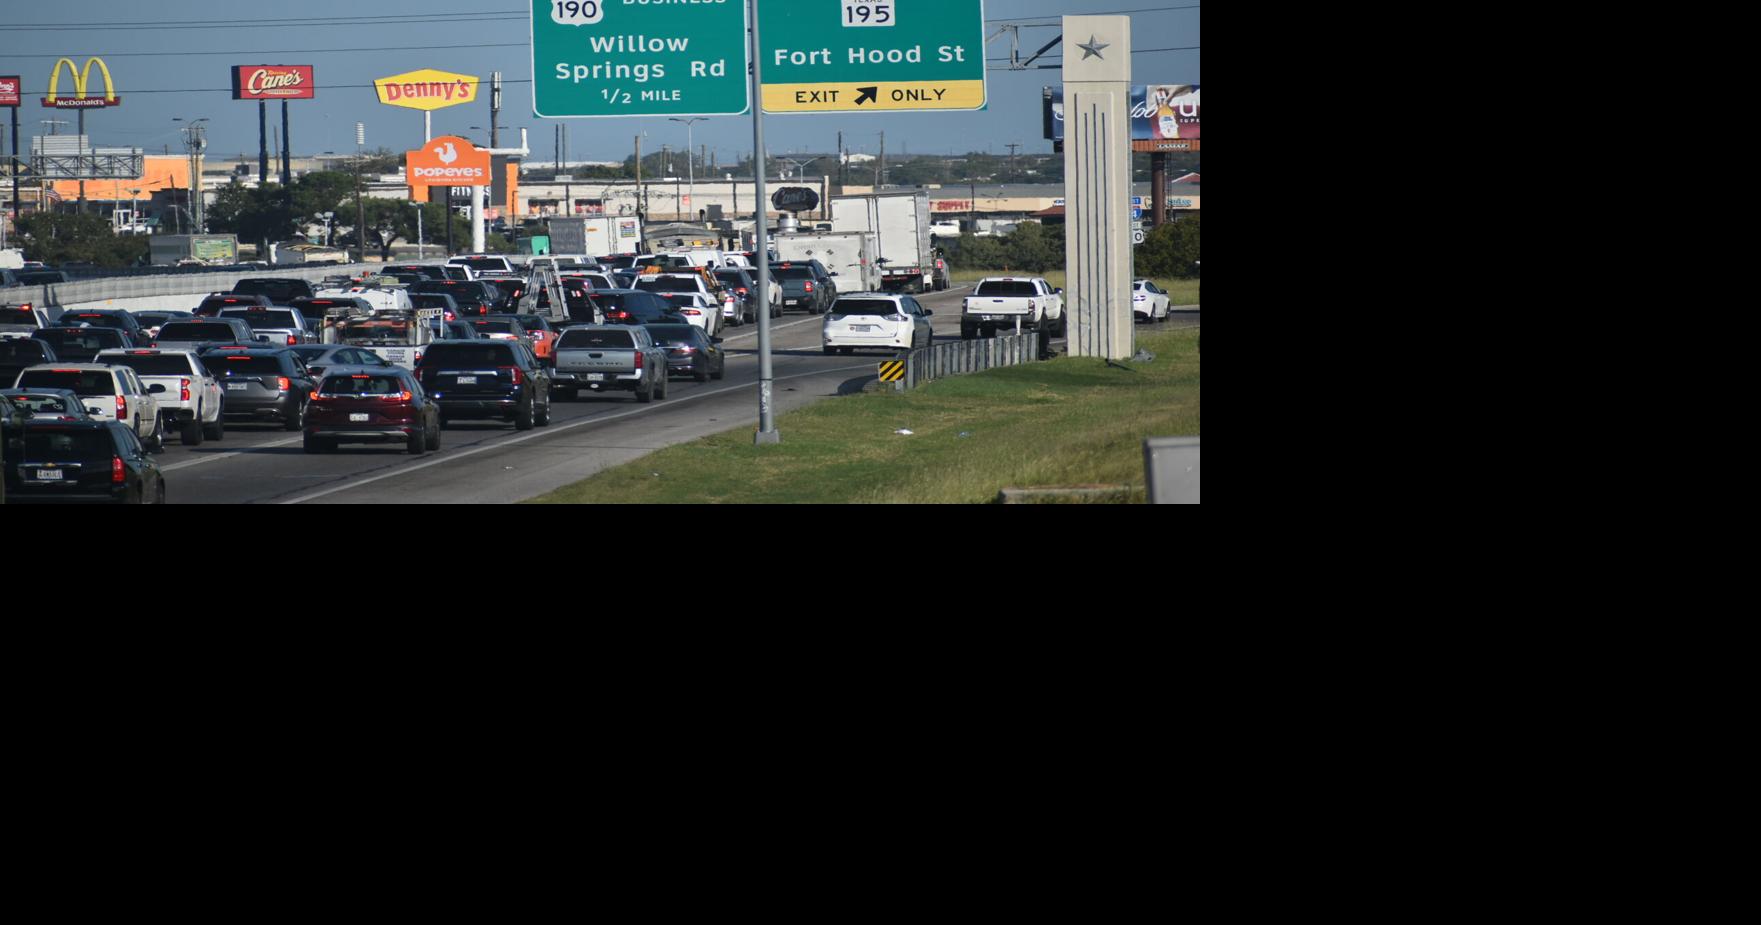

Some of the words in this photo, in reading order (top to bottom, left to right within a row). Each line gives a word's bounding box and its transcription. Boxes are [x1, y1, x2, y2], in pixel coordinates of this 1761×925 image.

[557, 1, 597, 18] 190
[846, 5, 890, 23] 195
[590, 35, 689, 53] Willow
[774, 48, 832, 65] Fort
[848, 45, 921, 64] Hood
[938, 45, 965, 62] St
[555, 61, 665, 83] Springs
[690, 59, 725, 77] Rd
[247, 69, 304, 94] Cane's
[384, 79, 470, 101] Denny's
[601, 88, 631, 104] 1/2
[641, 90, 681, 101] MILE
[796, 90, 839, 103] EXIT
[891, 89, 946, 102] ONLY
